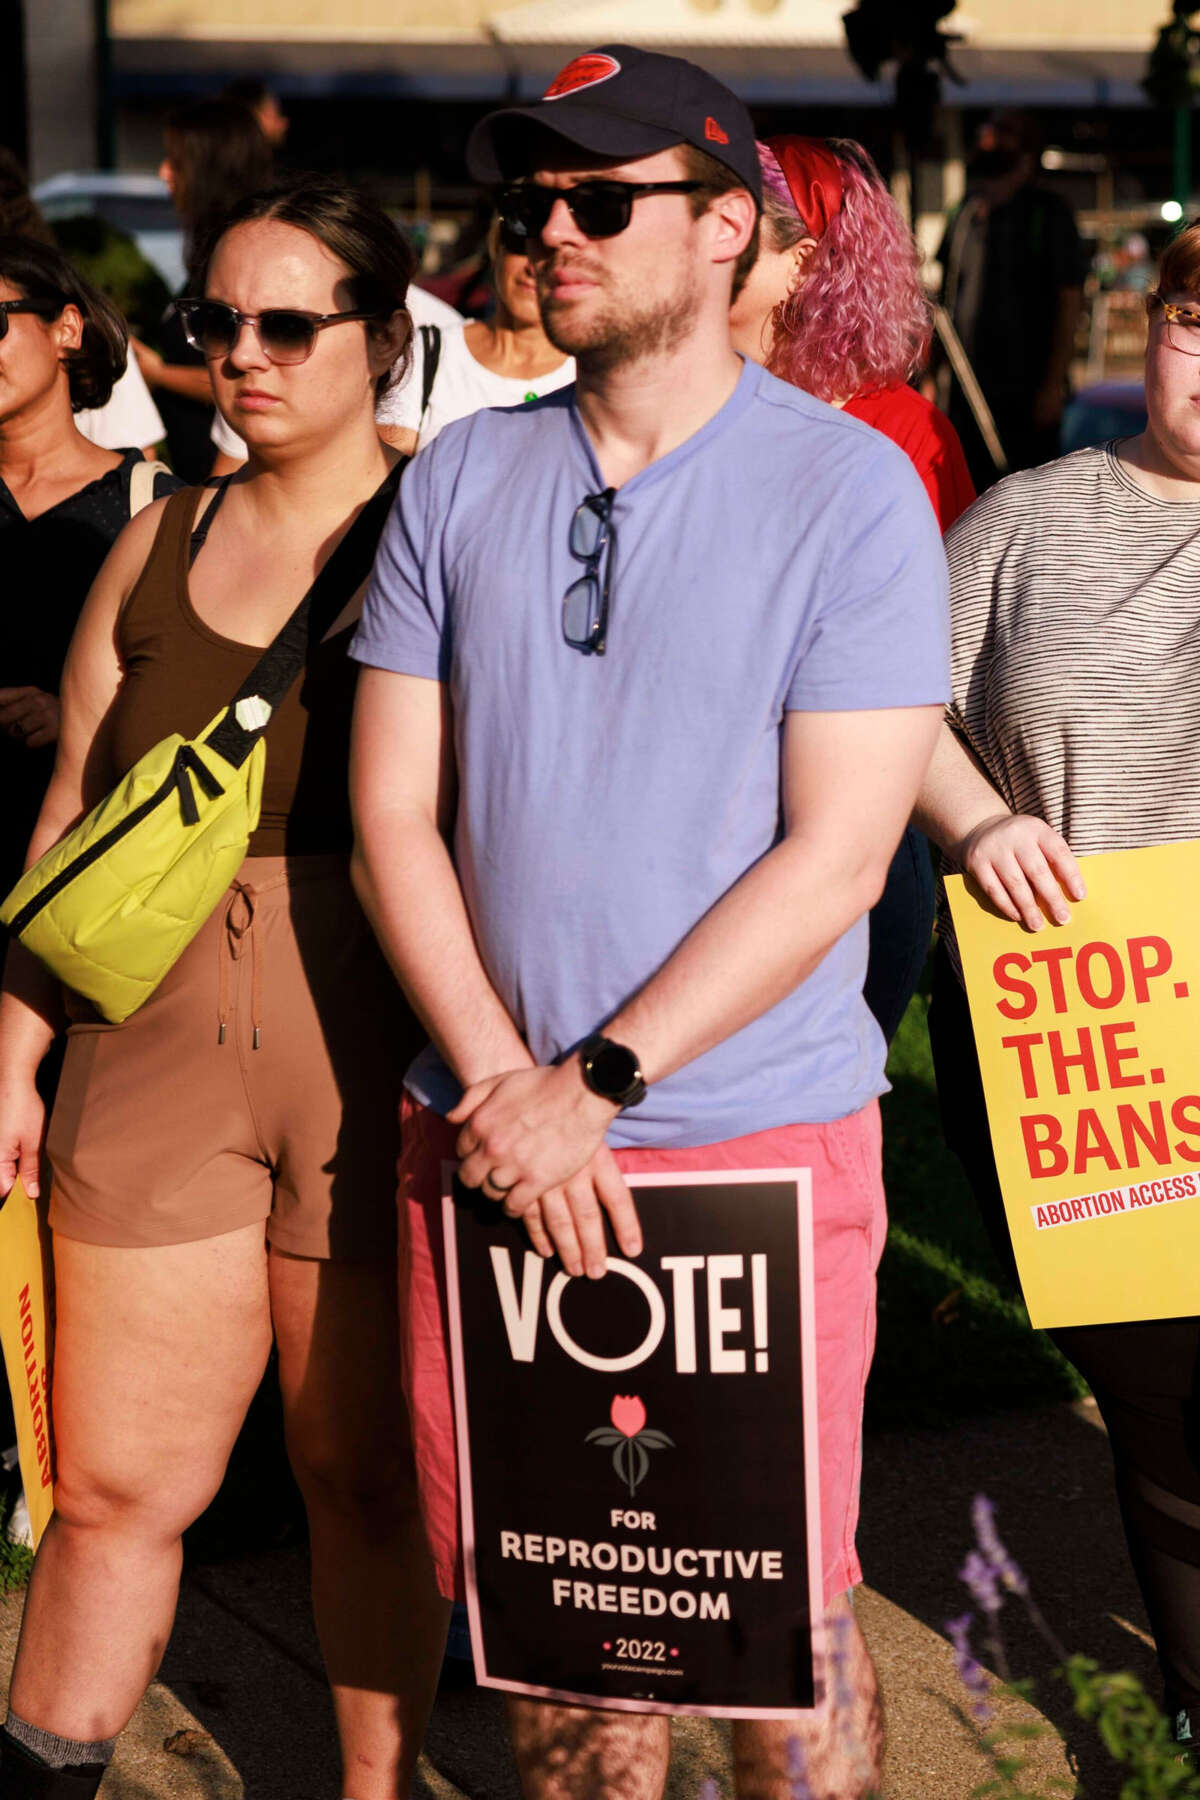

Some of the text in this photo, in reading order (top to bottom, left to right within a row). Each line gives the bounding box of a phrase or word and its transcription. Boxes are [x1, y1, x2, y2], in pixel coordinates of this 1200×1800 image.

[993, 935, 1189, 1020] STOP.
[1001, 1021, 1166, 1099] THE.
[1036, 1190, 1126, 1228] ABORTION
[1129, 1175, 1198, 1209] ACCESS
[489, 1246, 769, 1374] VOTE!
[610, 1510, 656, 1530] FOR
[500, 1531, 784, 1580] REPRODUCTIVE
[552, 1579, 731, 1620] FREEDOM
[616, 1638, 666, 1662] 2022
